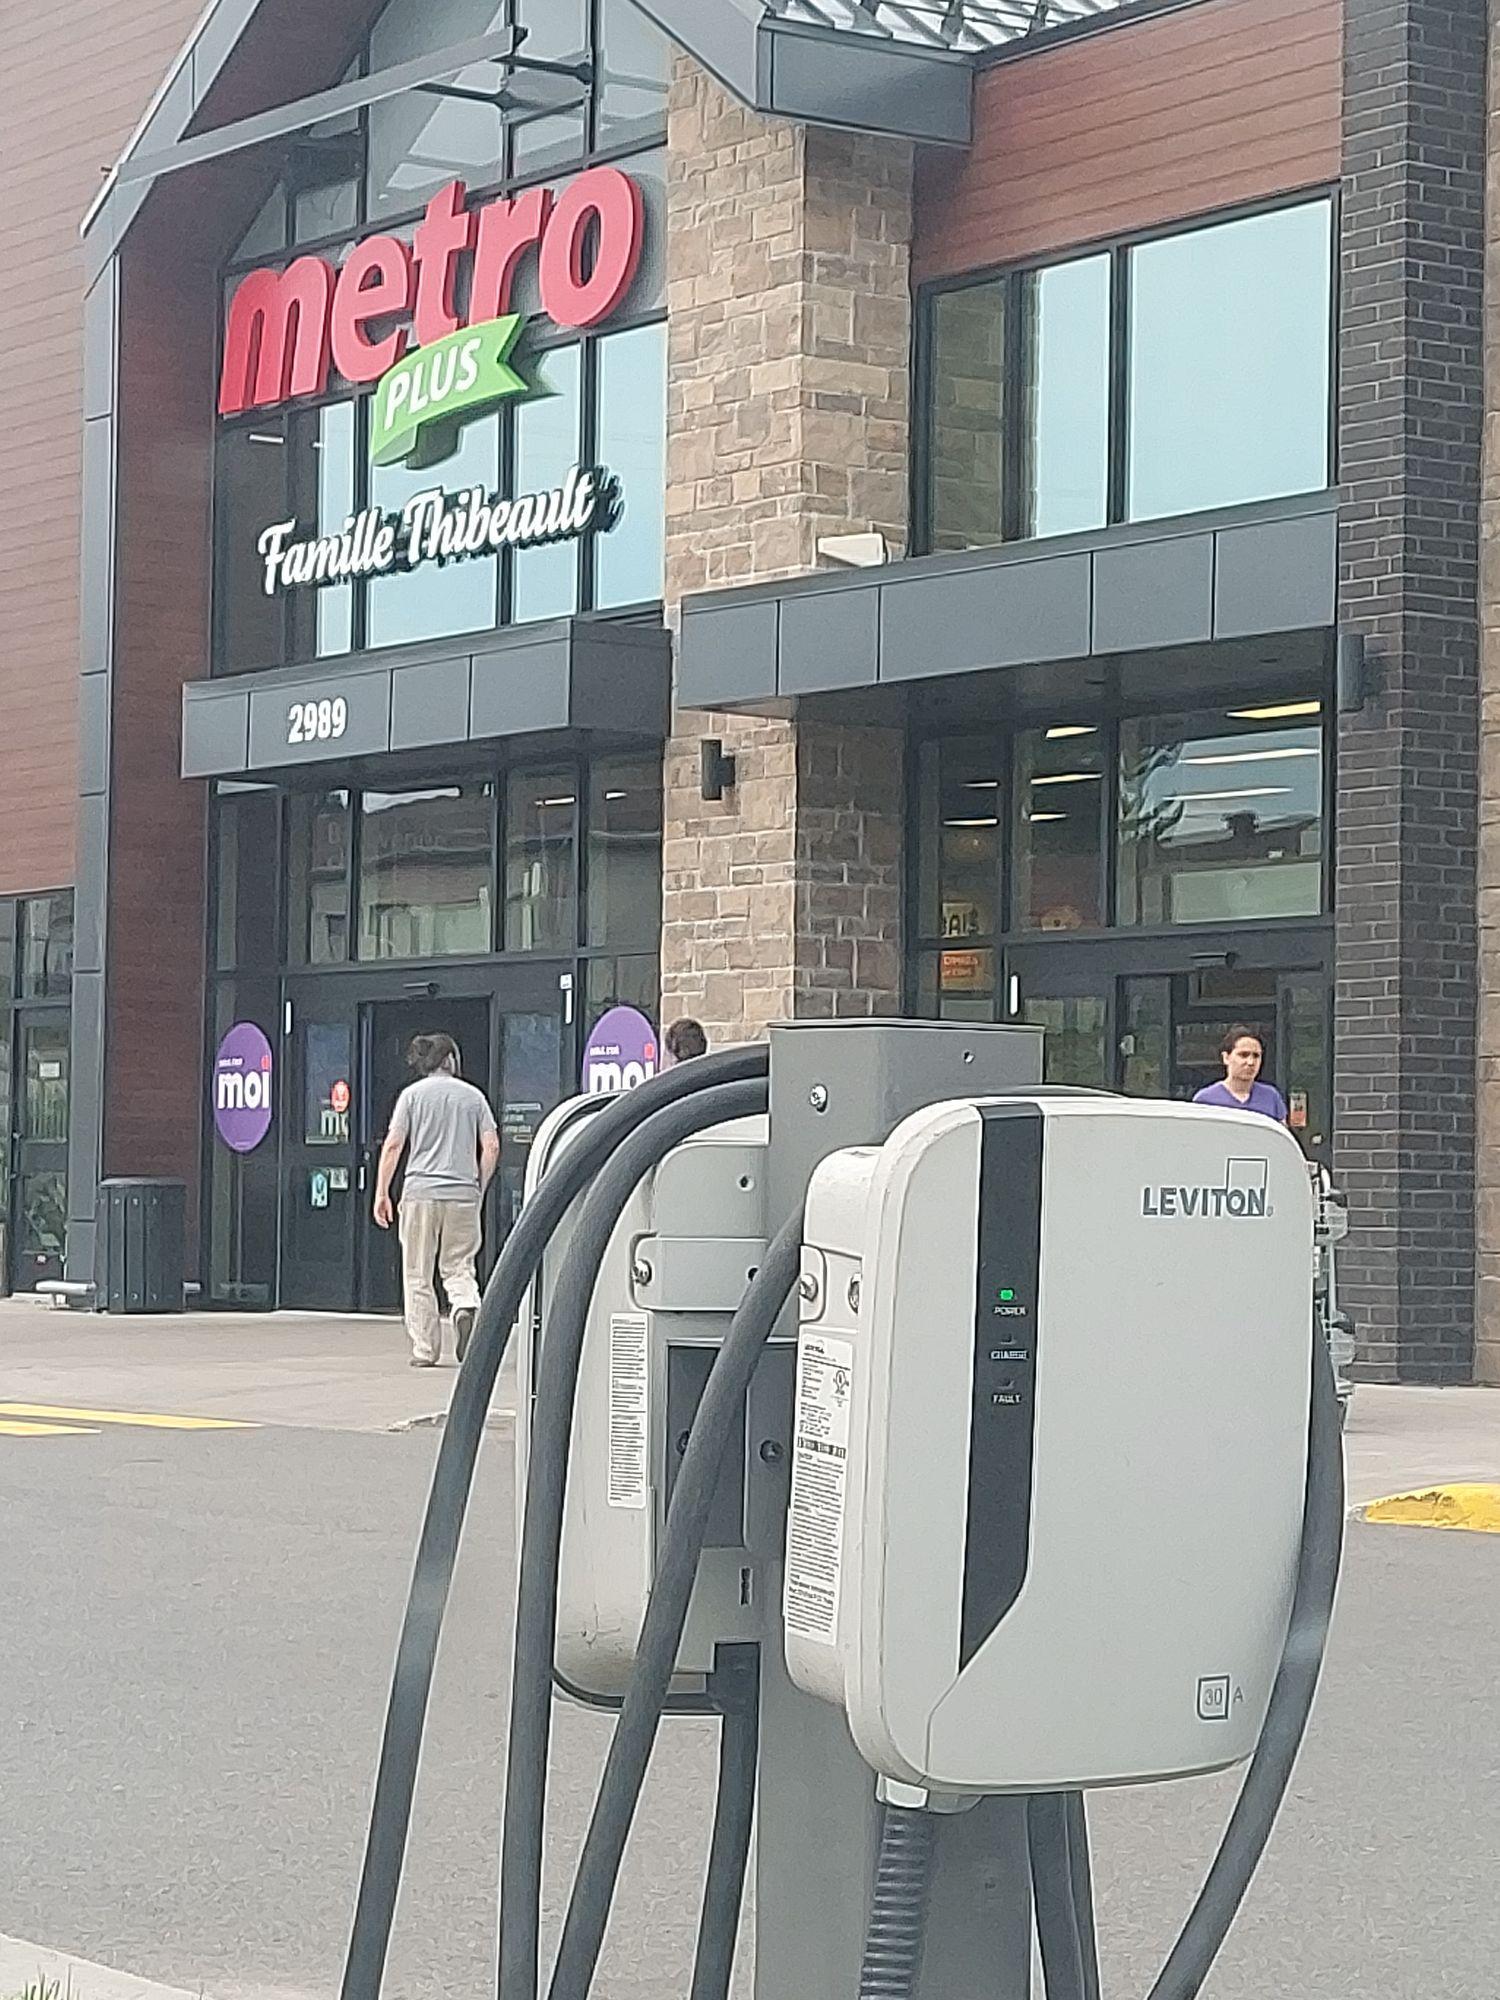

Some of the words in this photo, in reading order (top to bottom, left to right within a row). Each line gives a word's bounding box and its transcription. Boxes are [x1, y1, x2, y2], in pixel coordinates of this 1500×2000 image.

[219, 167, 645, 414] metro
[383, 337, 481, 432] PLUS
[258, 507, 396, 596] Famille
[403, 464, 597, 563] Thibeault
[287, 696, 347, 744] 2989
[217, 1054, 270, 1109] moi
[1142, 1187, 1266, 1217] LEVITON
[1205, 1688, 1223, 1706] 30
